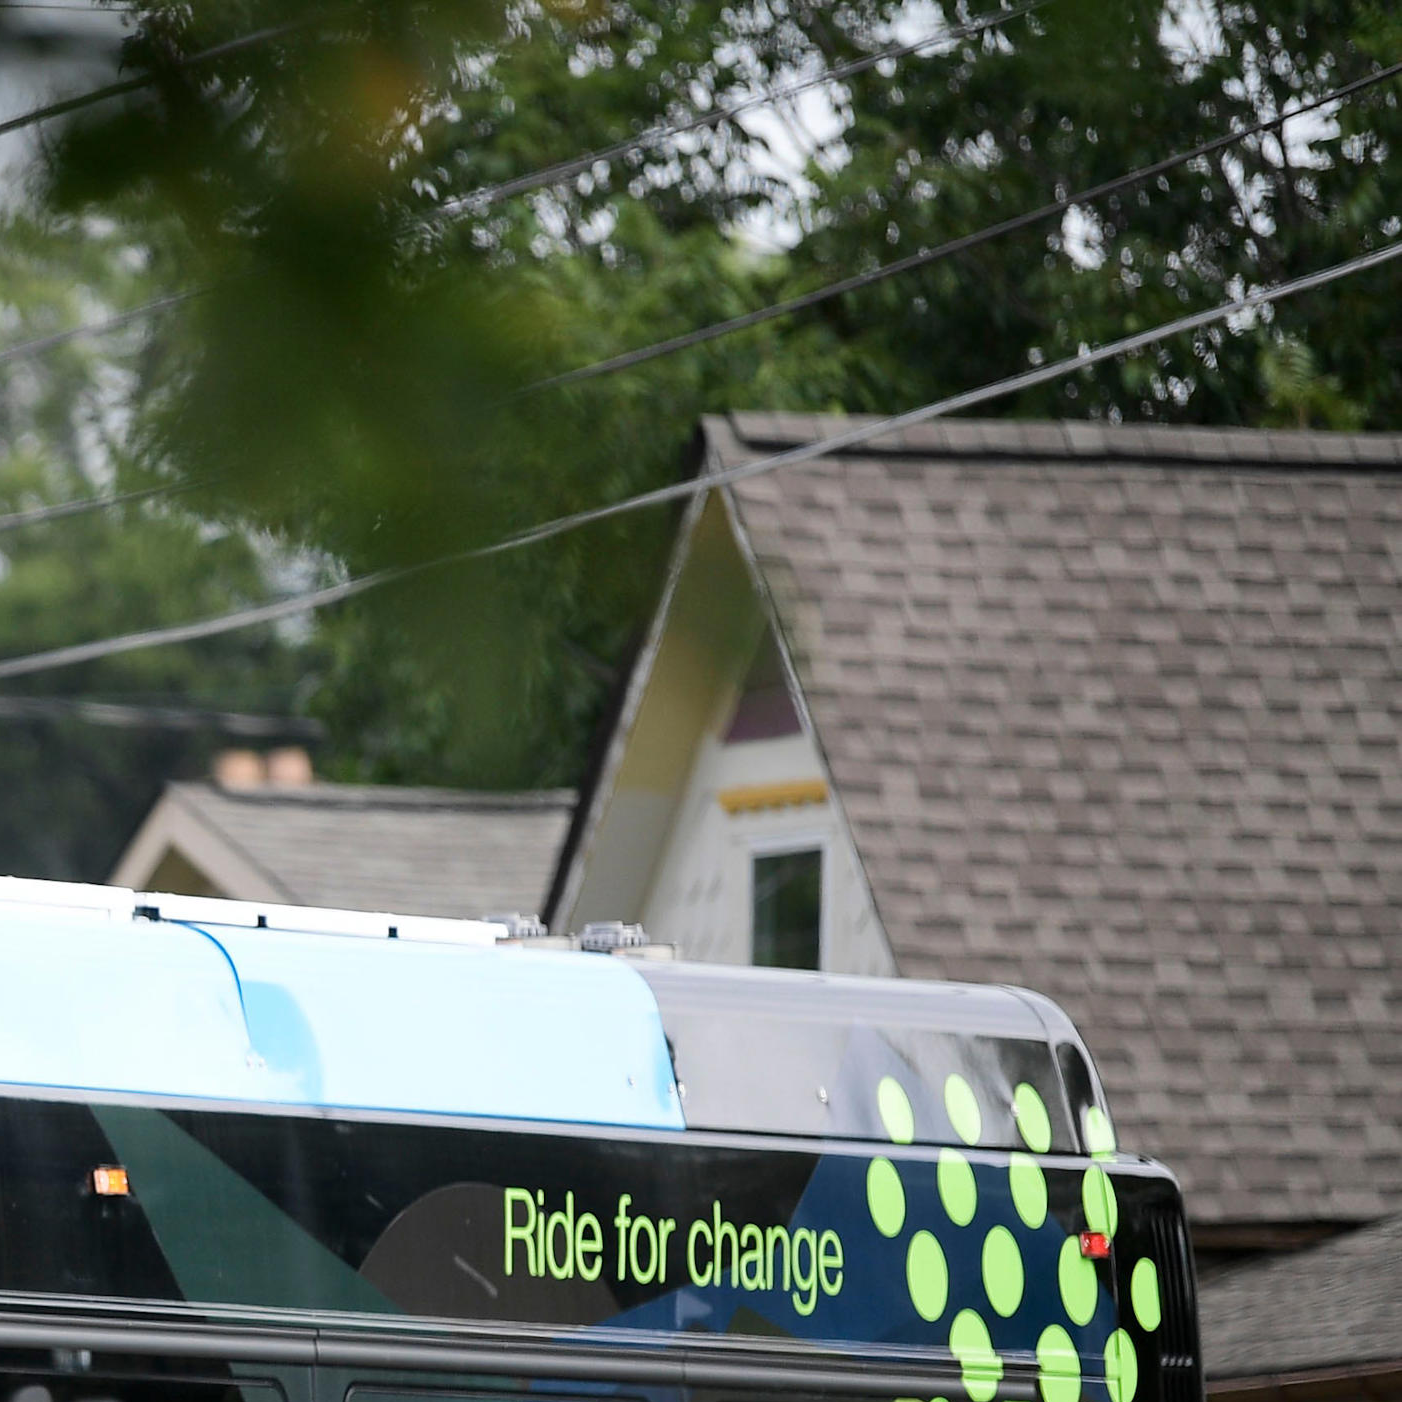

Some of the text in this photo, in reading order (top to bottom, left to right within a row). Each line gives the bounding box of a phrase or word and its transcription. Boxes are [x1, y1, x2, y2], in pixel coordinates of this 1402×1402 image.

[503, 1187, 845, 1317] Ride for change
